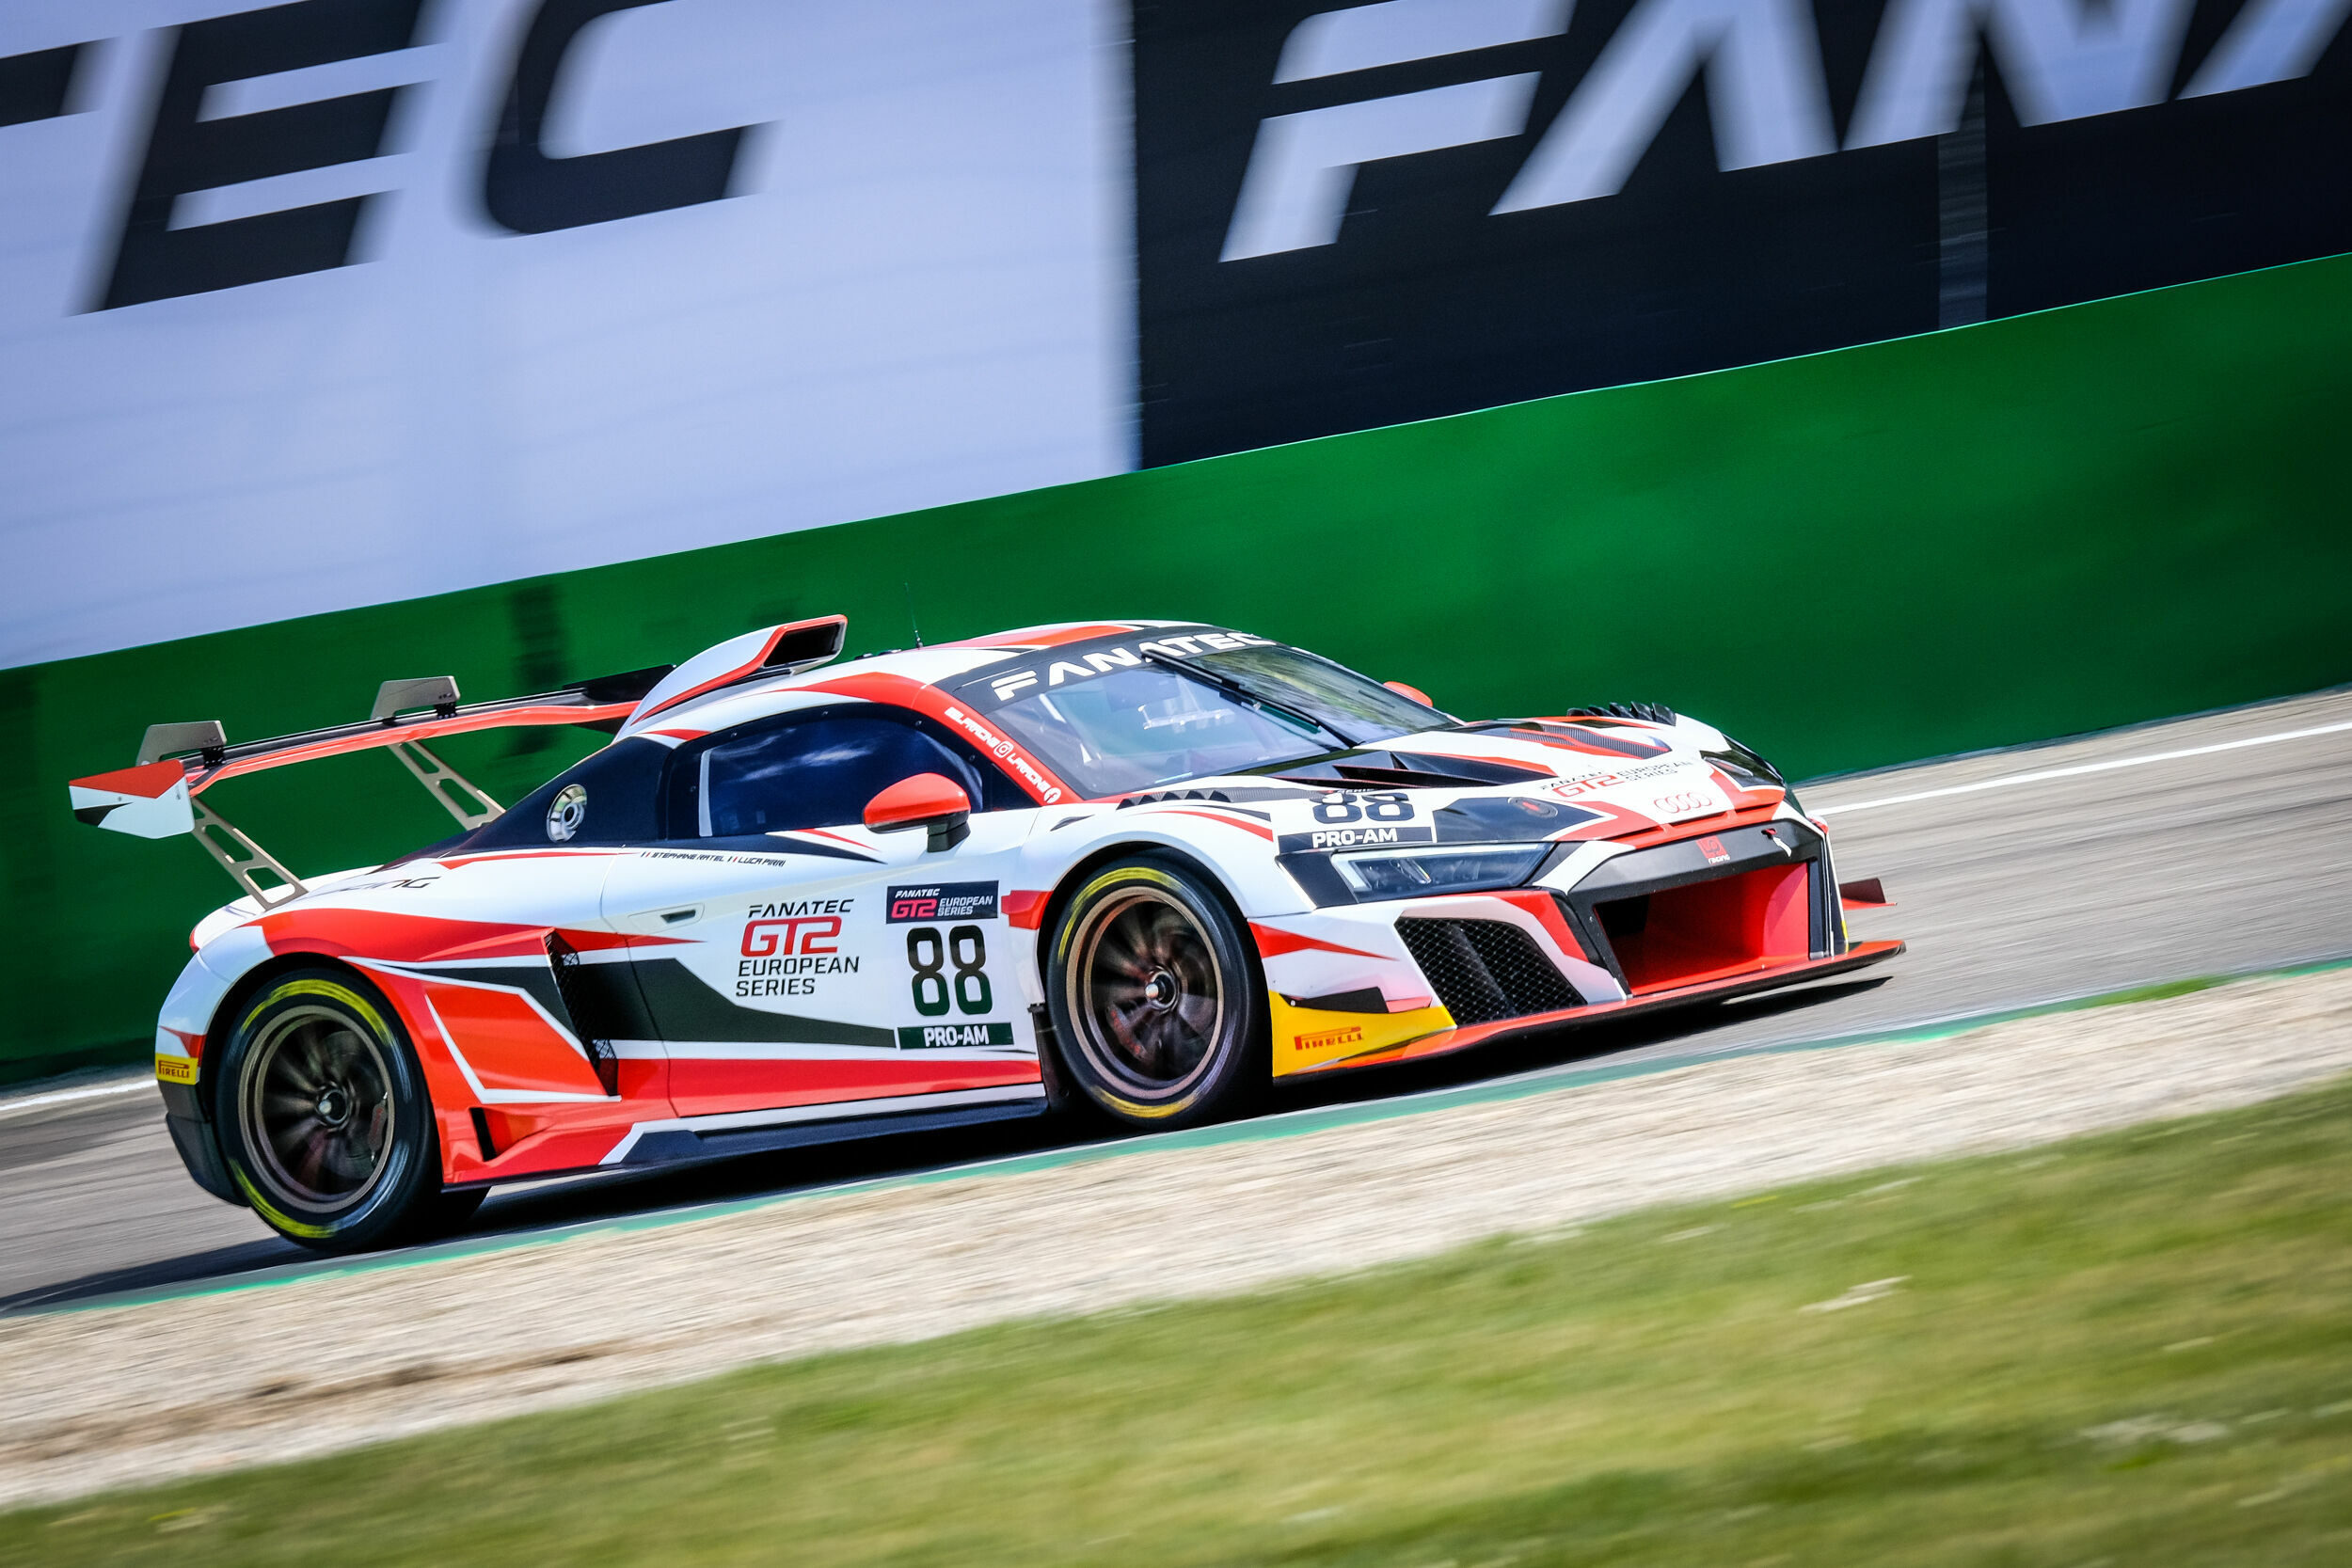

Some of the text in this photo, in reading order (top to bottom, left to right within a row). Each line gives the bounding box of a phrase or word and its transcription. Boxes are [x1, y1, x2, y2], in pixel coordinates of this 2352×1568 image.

[0, 0, 784, 316] EC
[991, 632, 1277, 702] FANATEC
[1552, 774, 1626, 797] GT2
[1309, 792, 1416, 824] 88
[1311, 828, 1398, 848] PRO-AM
[739, 856, 761, 864] LUCA
[896, 888, 941, 899] FANATEC
[939, 895, 993, 907] EUROPEAN
[748, 898, 854, 918] FANATEC
[891, 898, 938, 919] GT2
[937, 906, 974, 917] SERIES
[740, 915, 842, 958] GT2
[739, 956, 860, 977] EUROPEAN
[906, 925, 993, 1017] 88
[736, 977, 816, 997] SERIES
[923, 1024, 990, 1047] PRO-AM
[1294, 1026, 1362, 1051] PIRELLI
[158, 1059, 190, 1079] PIRELLI
